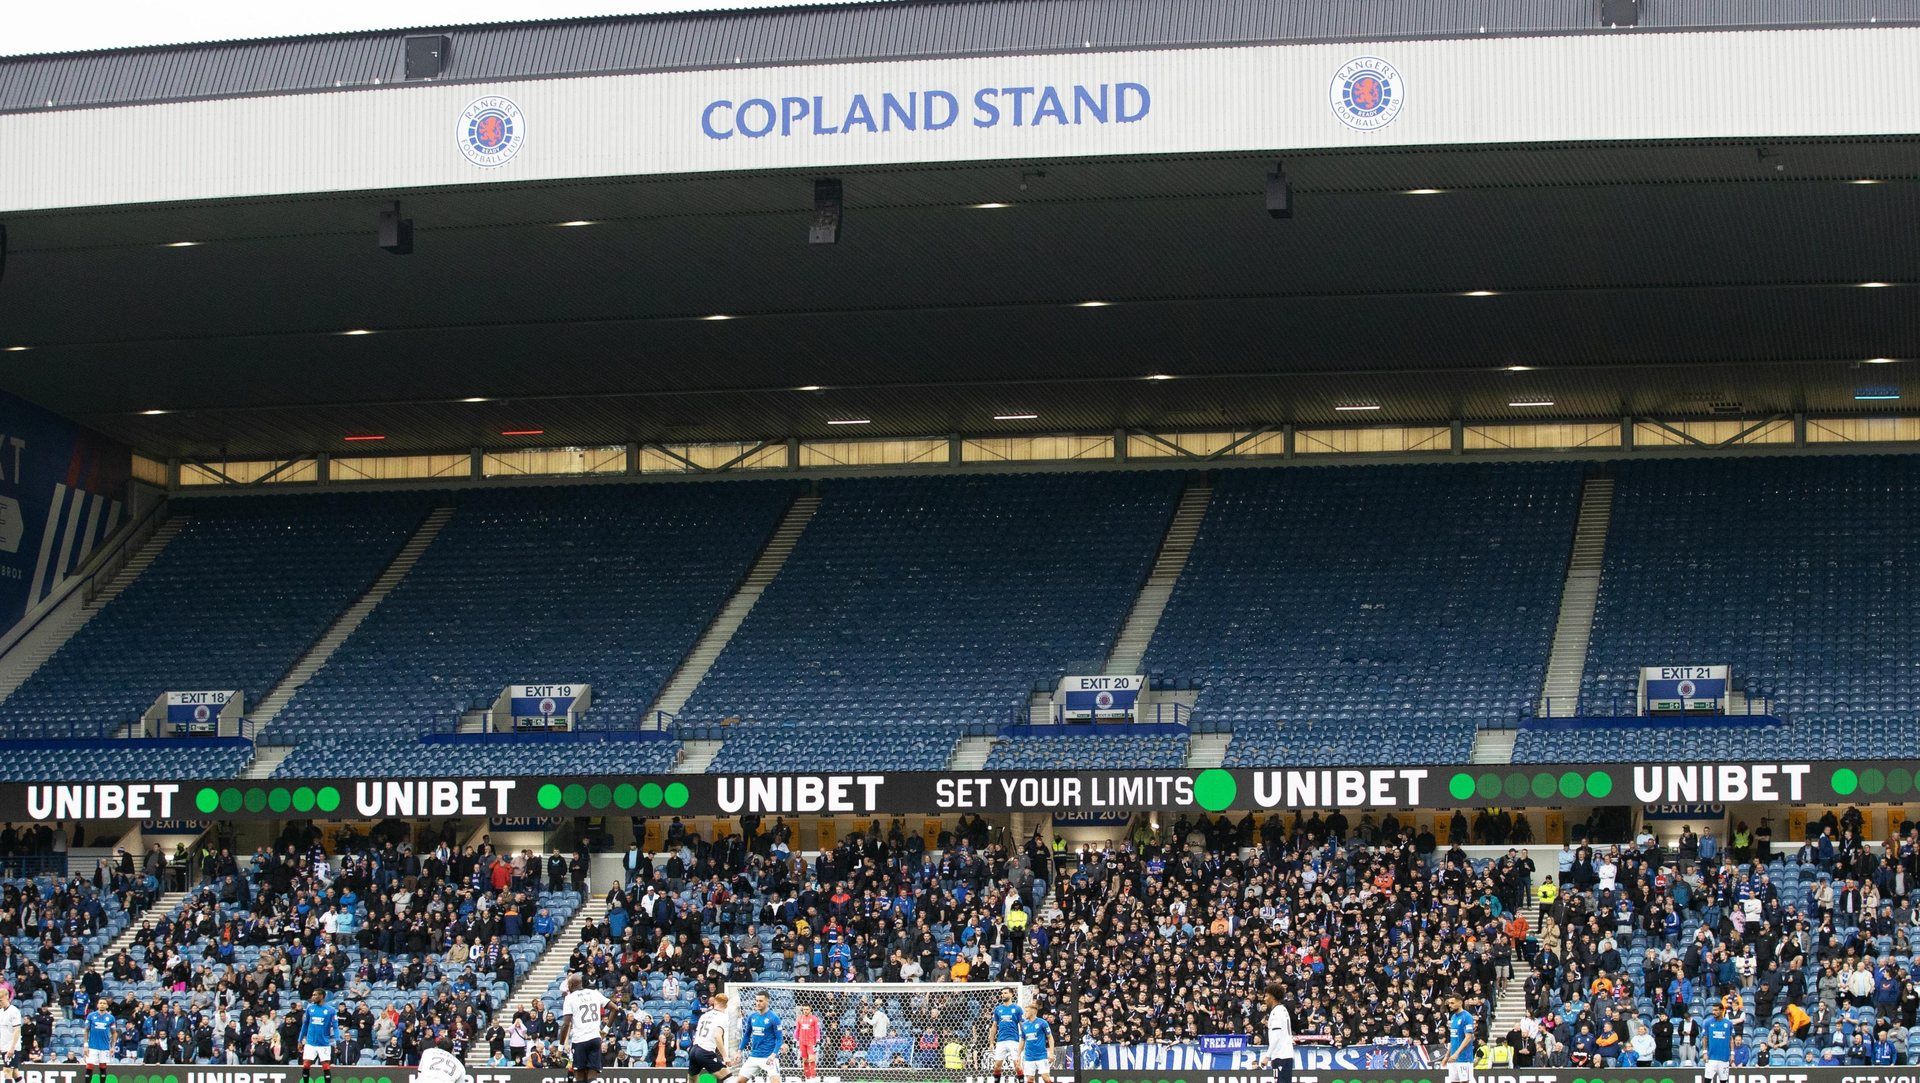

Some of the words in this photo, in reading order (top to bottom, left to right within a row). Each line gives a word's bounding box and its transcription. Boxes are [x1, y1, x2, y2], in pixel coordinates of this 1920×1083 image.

[1338, 60, 1397, 81] RANGERS
[465, 98, 518, 120] RANGERS
[701, 90, 960, 140] COPLAND
[973, 82, 1151, 128] STAND
[1335, 101, 1380, 127] FOOTBALL
[1381, 98, 1400, 121] CLUB
[461, 139, 503, 163] FOOTBALL
[503, 135, 521, 158] CLUB
[1081, 678, 1111, 689] EXIT
[1114, 677, 1129, 689] 20
[1662, 668, 1693, 679] EXIT
[1696, 667, 1711, 679] 21
[181, 692, 208, 703] EXIT
[211, 692, 225, 703] 18
[525, 686, 554, 697] EXIT
[557, 686, 571, 696] 19
[717, 775, 885, 813] UNIBET
[936, 778, 992, 808] SET
[1000, 777, 1081, 808] YOUR
[1091, 775, 1195, 807] LIMITS
[1253, 769, 1429, 808] UNIBET
[1633, 764, 1811, 803] UNIBET
[27, 784, 180, 820] UNIBET
[355, 780, 517, 817] UNIBET
[1661, 804, 1688, 813] EXIT
[156, 820, 180, 829] EXIT
[186, 820, 197, 828] 18
[505, 816, 530, 825] EXIT
[1068, 811, 1094, 820] EXIT
[579, 1003, 599, 1024] 28
[1203, 1037, 1226, 1049] FREE
[1228, 1037, 1243, 1048] AW
[429, 1056, 457, 1077] 29
